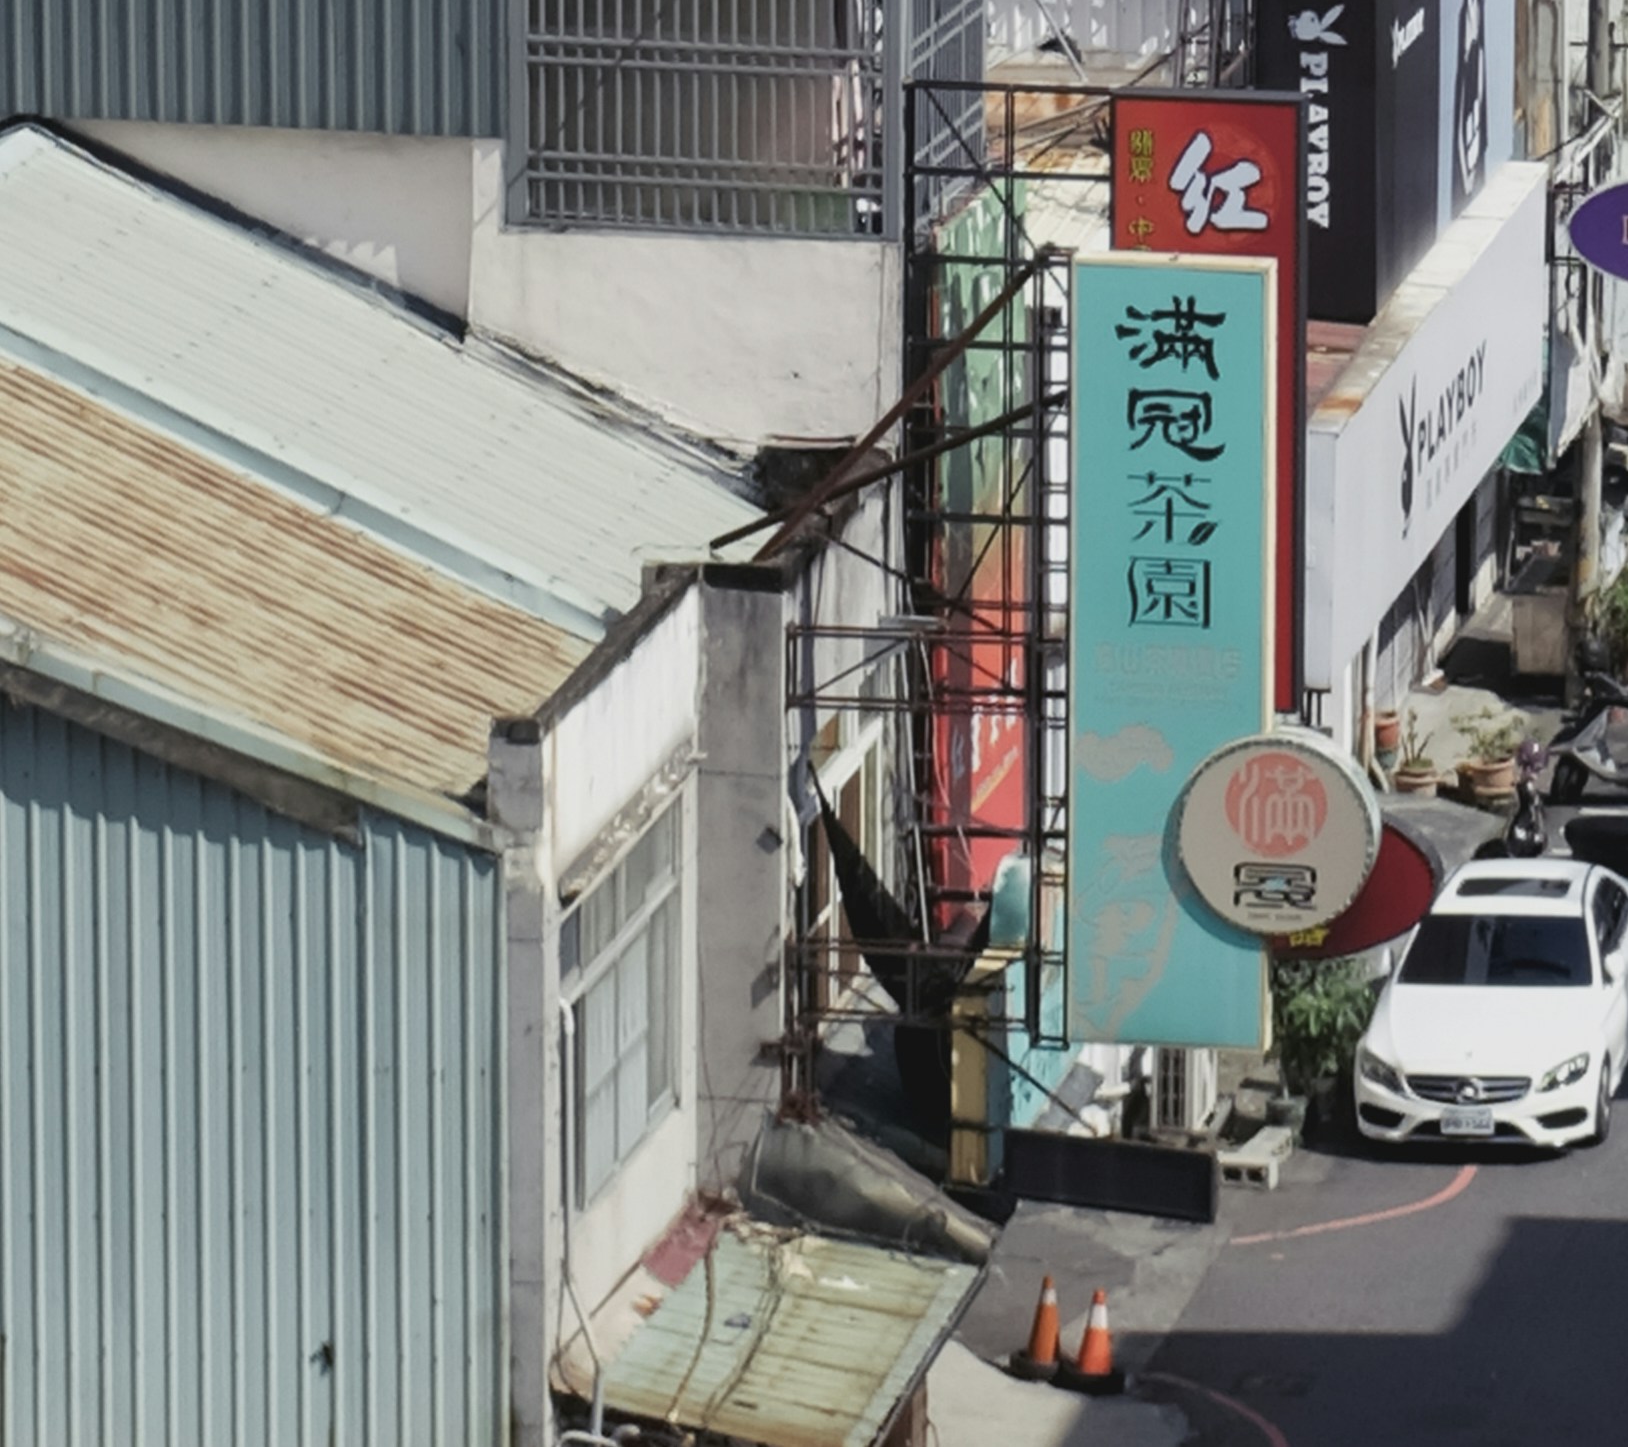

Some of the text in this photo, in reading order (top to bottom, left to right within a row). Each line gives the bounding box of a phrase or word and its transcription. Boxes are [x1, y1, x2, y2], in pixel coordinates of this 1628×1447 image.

[1168, 131, 1269, 235] 紅
[1300, 51, 1330, 230] PLAYBOY
[1114, 294, 1228, 630] 滿冠茶園
[1417, 338, 1488, 478] PLAYBOY
